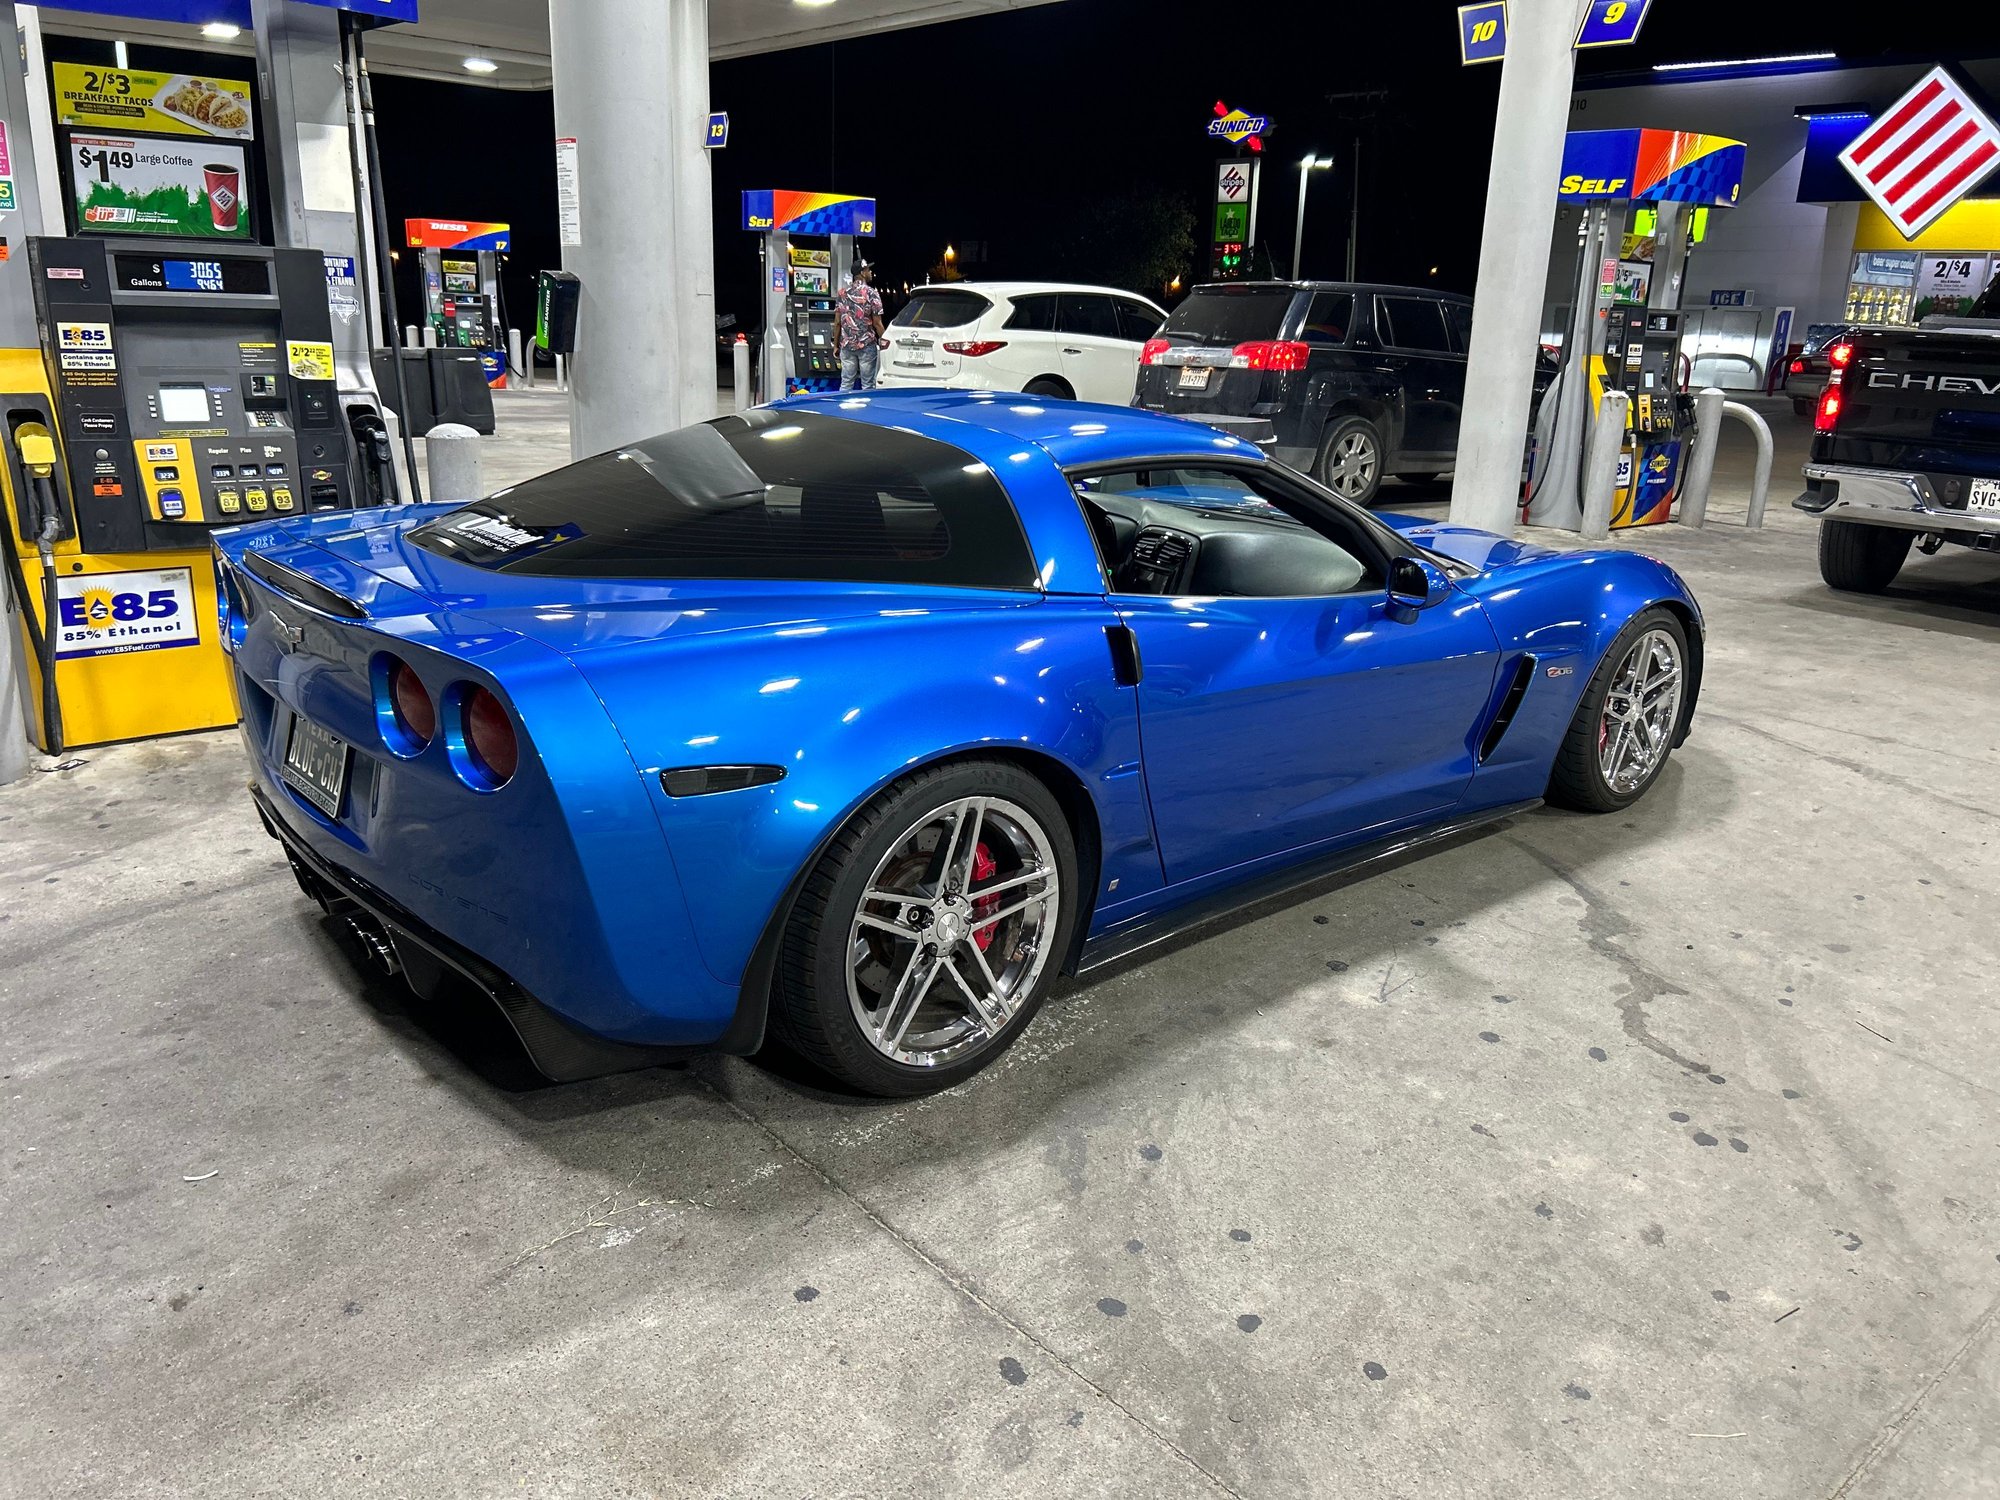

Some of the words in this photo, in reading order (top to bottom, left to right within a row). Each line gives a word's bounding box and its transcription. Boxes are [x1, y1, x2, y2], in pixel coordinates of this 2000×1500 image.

[1603, 2, 1628, 24] 9
[1471, 20, 1498, 43] 10
[84, 71, 131, 95] 2/$3
[64, 91, 121, 104] BREAKFAST
[124, 96, 154, 107] TACOS
[712, 124, 724, 137] 13
[1210, 118, 1264, 134] SUNOCO
[136, 152, 160, 166] Large
[162, 154, 193, 167] Coffee
[1220, 178, 1245, 188] stripes
[1559, 175, 1627, 195] SELF
[1731, 183, 1741, 202] 9
[98, 211, 115, 221] UP
[749, 215, 773, 228] SELF
[430, 222, 469, 232] DIESEL
[860, 221, 873, 232] 13
[495, 241, 508, 250] 17
[153, 263, 160, 274] $
[328, 267, 335, 277] UP
[337, 267, 344, 277] TO
[1934, 260, 1972, 279] 2/$4
[131, 278, 162, 288] Gallons
[1714, 293, 1741, 304] ICE
[223, 498, 237, 507] 87
[250, 496, 264, 506] 89
[276, 495, 290, 504] 93
[1971, 491, 1997, 507] SVG
[64, 630, 102, 642] 85%
[108, 622, 182, 638] Ethanol
[95, 643, 161, 656] www.E85Fuel.com
[288, 729, 318, 779] BLUE
